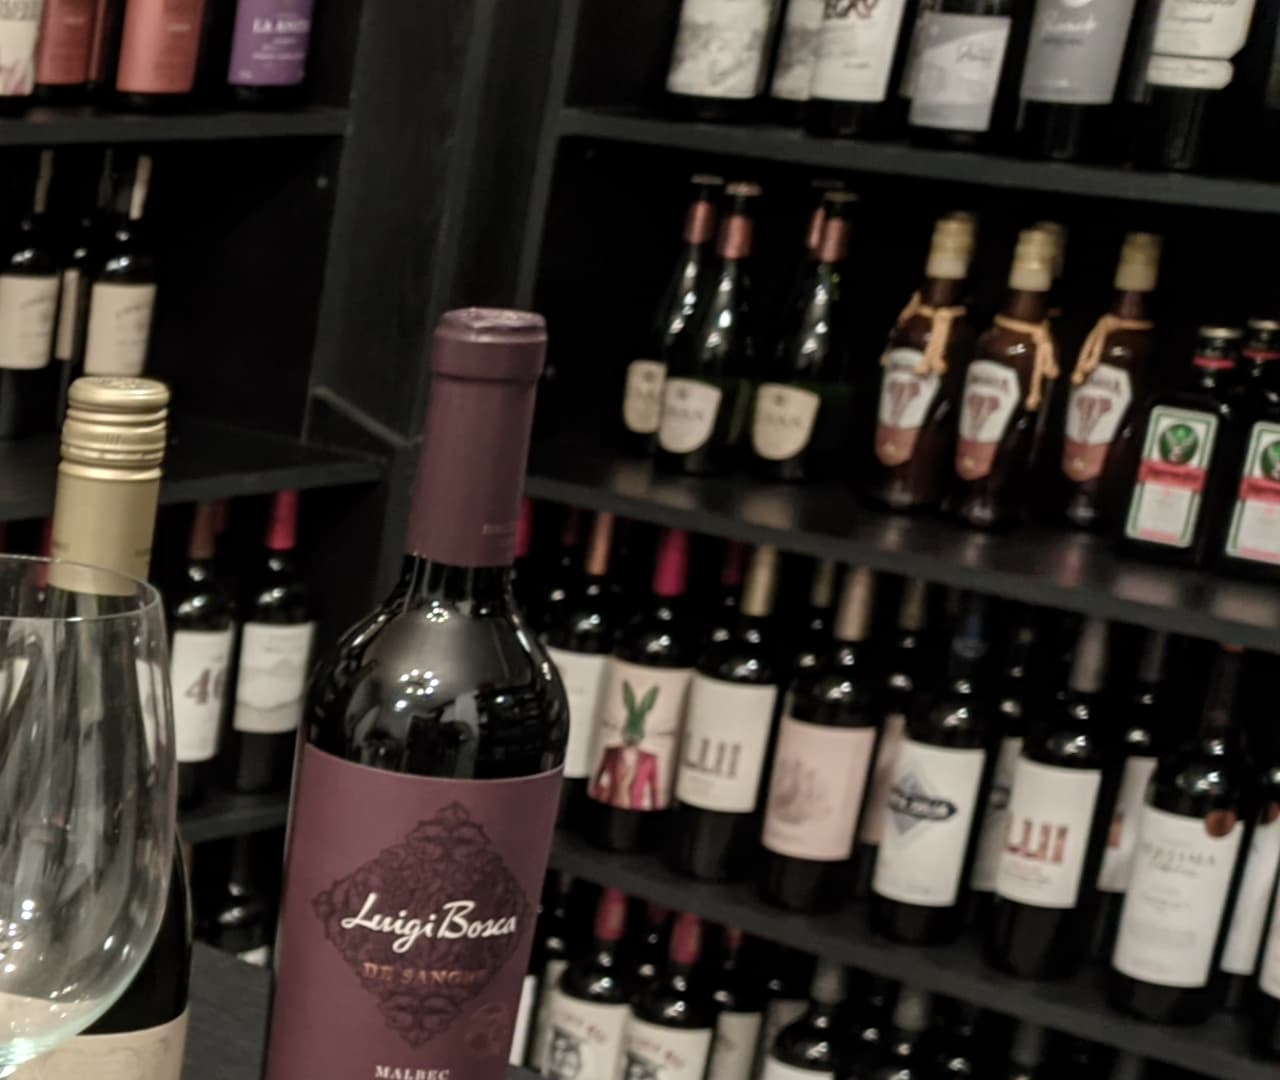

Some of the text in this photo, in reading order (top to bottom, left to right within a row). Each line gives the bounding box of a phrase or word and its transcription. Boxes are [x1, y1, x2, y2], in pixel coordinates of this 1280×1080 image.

[342, 893, 517, 953] Luigi Bosca
[363, 962, 393, 981] DE
